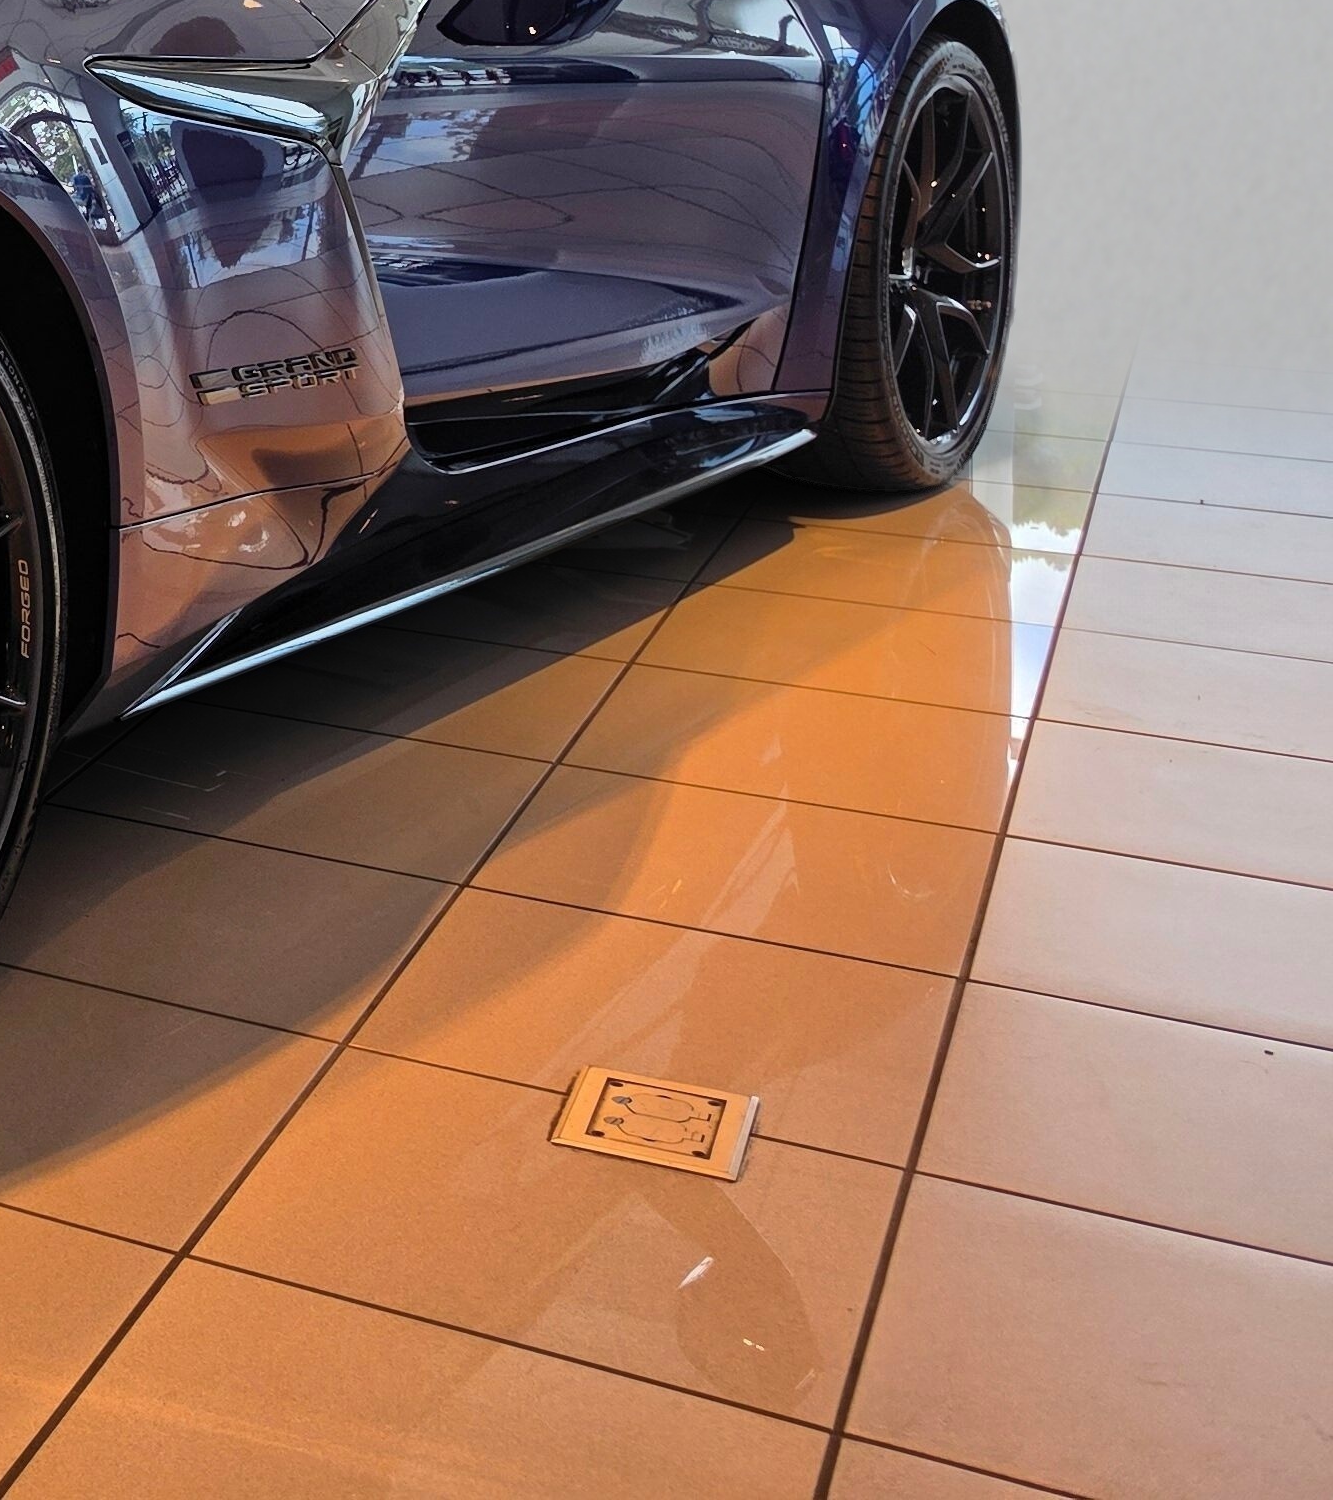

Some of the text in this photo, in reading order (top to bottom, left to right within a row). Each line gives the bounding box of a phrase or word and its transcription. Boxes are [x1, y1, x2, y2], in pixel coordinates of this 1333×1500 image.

[232, 348, 358, 382] GRAND
[239, 366, 358, 398] SPORT
[18, 559, 31, 659] FORGED
